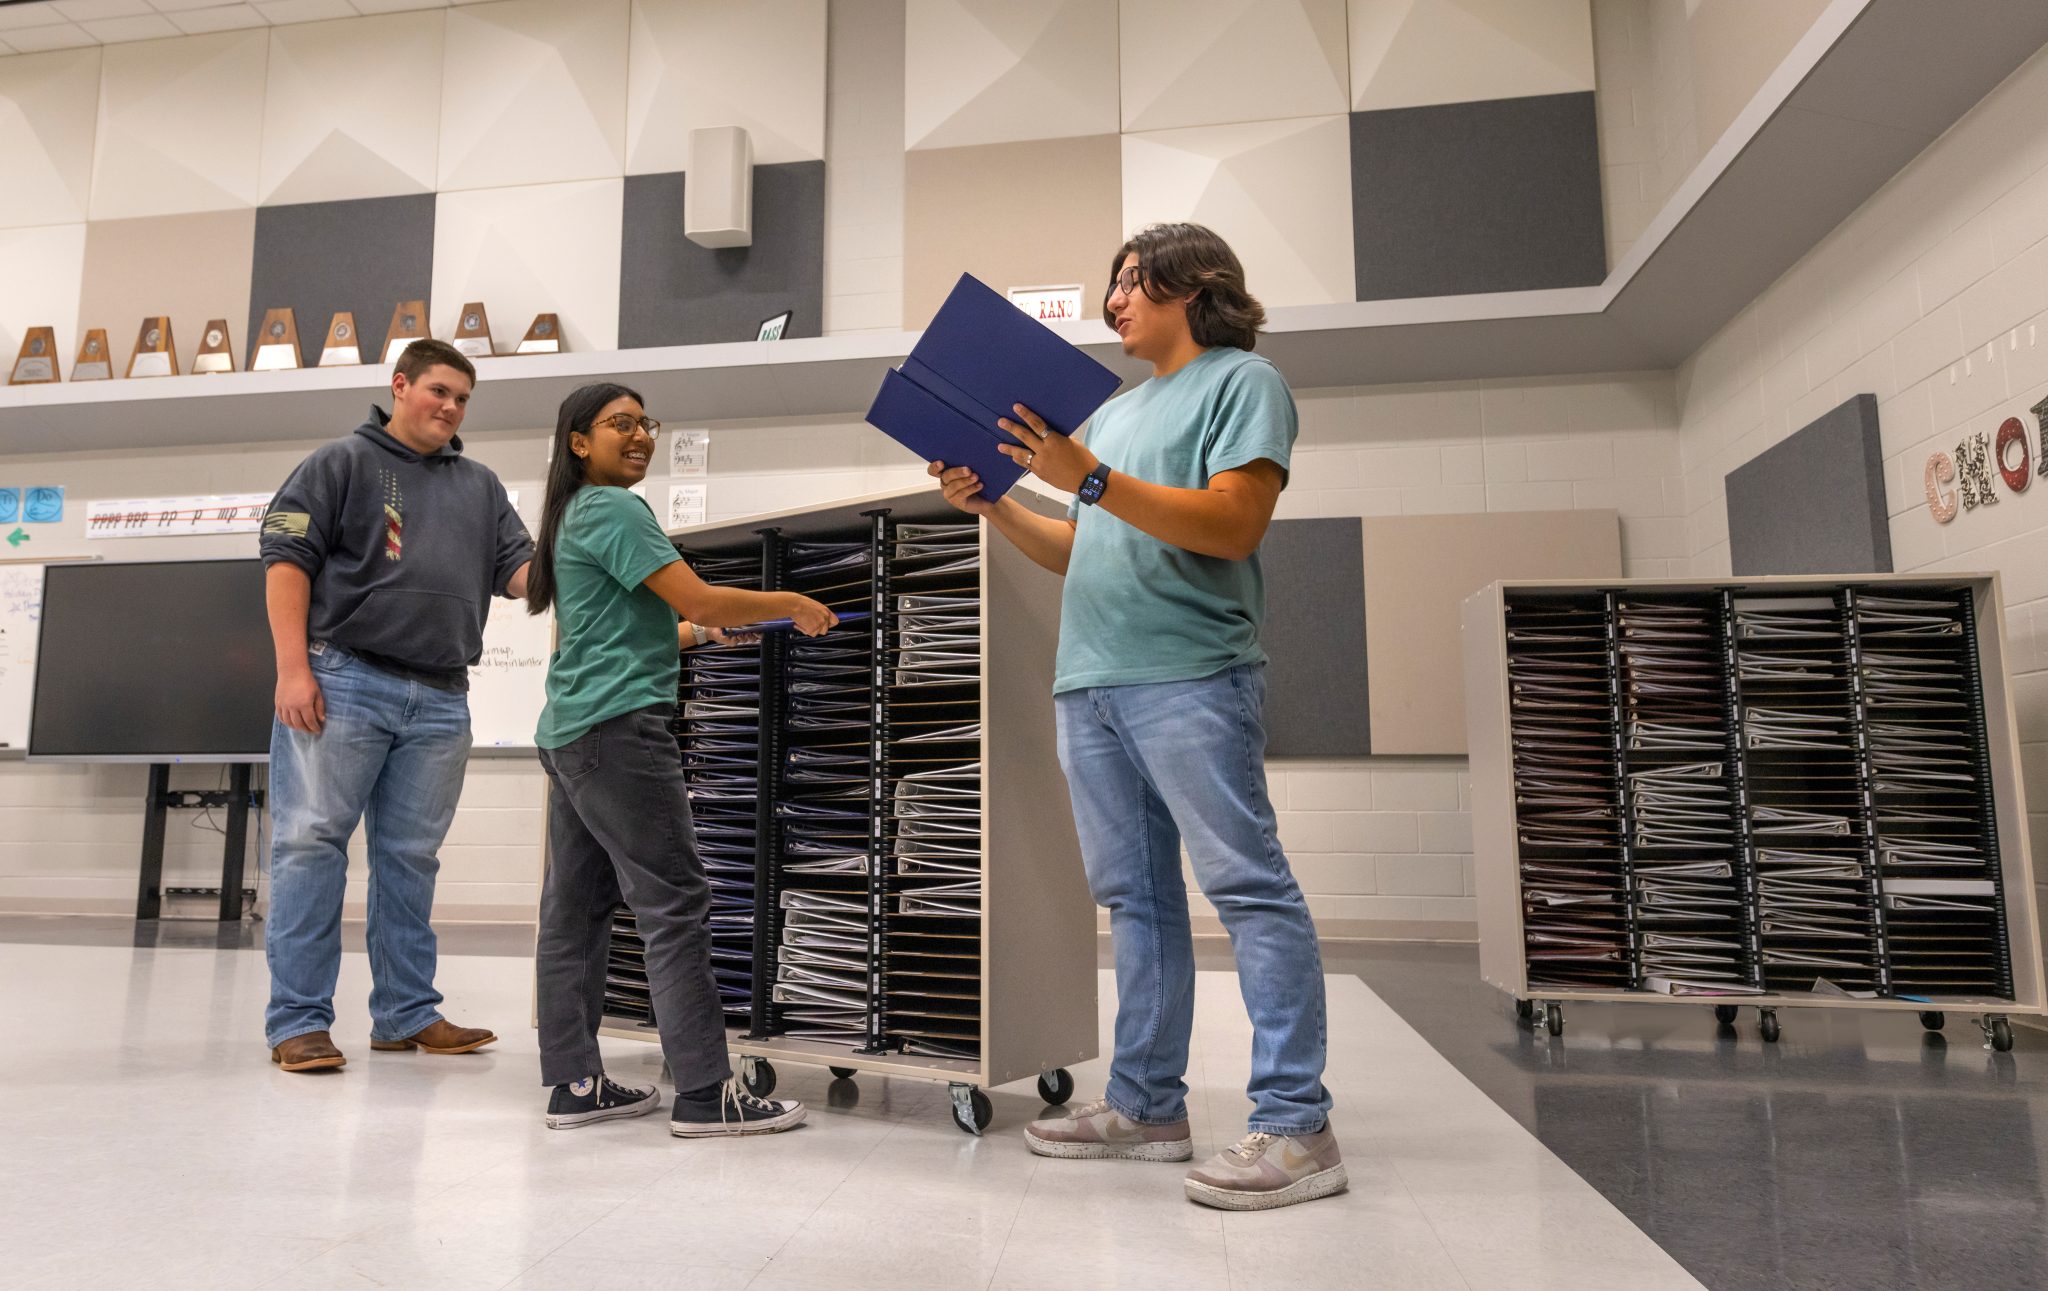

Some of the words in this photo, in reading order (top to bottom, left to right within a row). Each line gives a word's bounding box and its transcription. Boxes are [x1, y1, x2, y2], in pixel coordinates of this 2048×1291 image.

[125, 511, 149, 529] ppp
[158, 510, 178, 527] pp
[191, 508, 203, 526] p
[217, 507, 238, 524] mp
